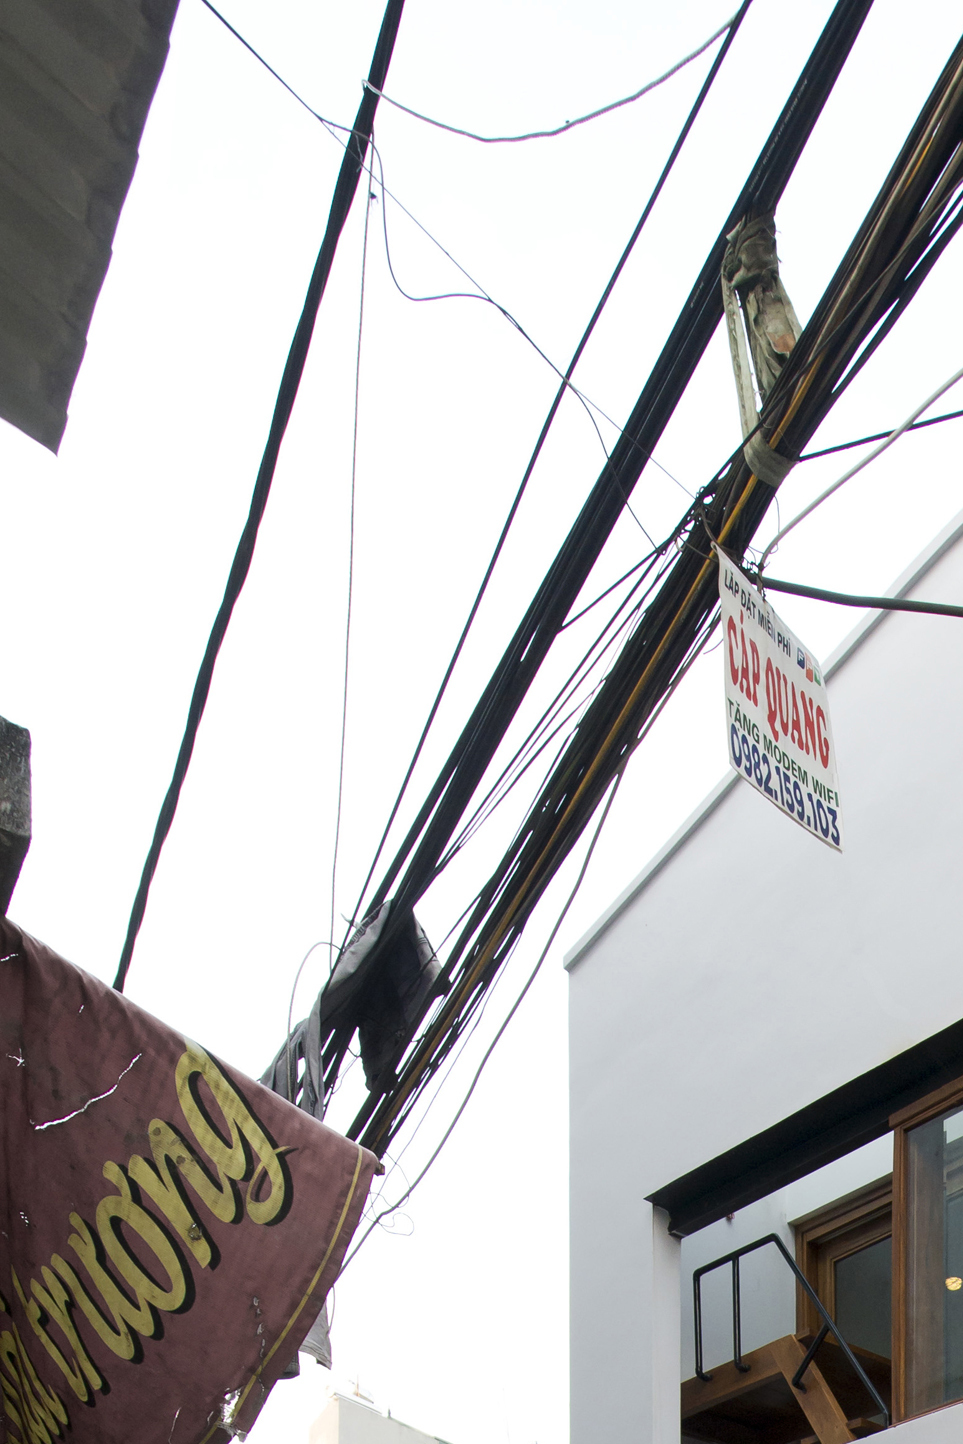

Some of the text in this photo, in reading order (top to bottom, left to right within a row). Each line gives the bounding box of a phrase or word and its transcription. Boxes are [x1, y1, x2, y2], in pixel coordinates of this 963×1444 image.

[724, 569, 739, 598] LẮP
[741, 588, 756, 619] ĐẶT
[777, 631, 791, 658] PHÍ
[727, 698, 839, 808] TẶNG MODEM WIFI
[765, 657, 830, 769] QUANG
[730, 723, 840, 846] 0982.159.103
